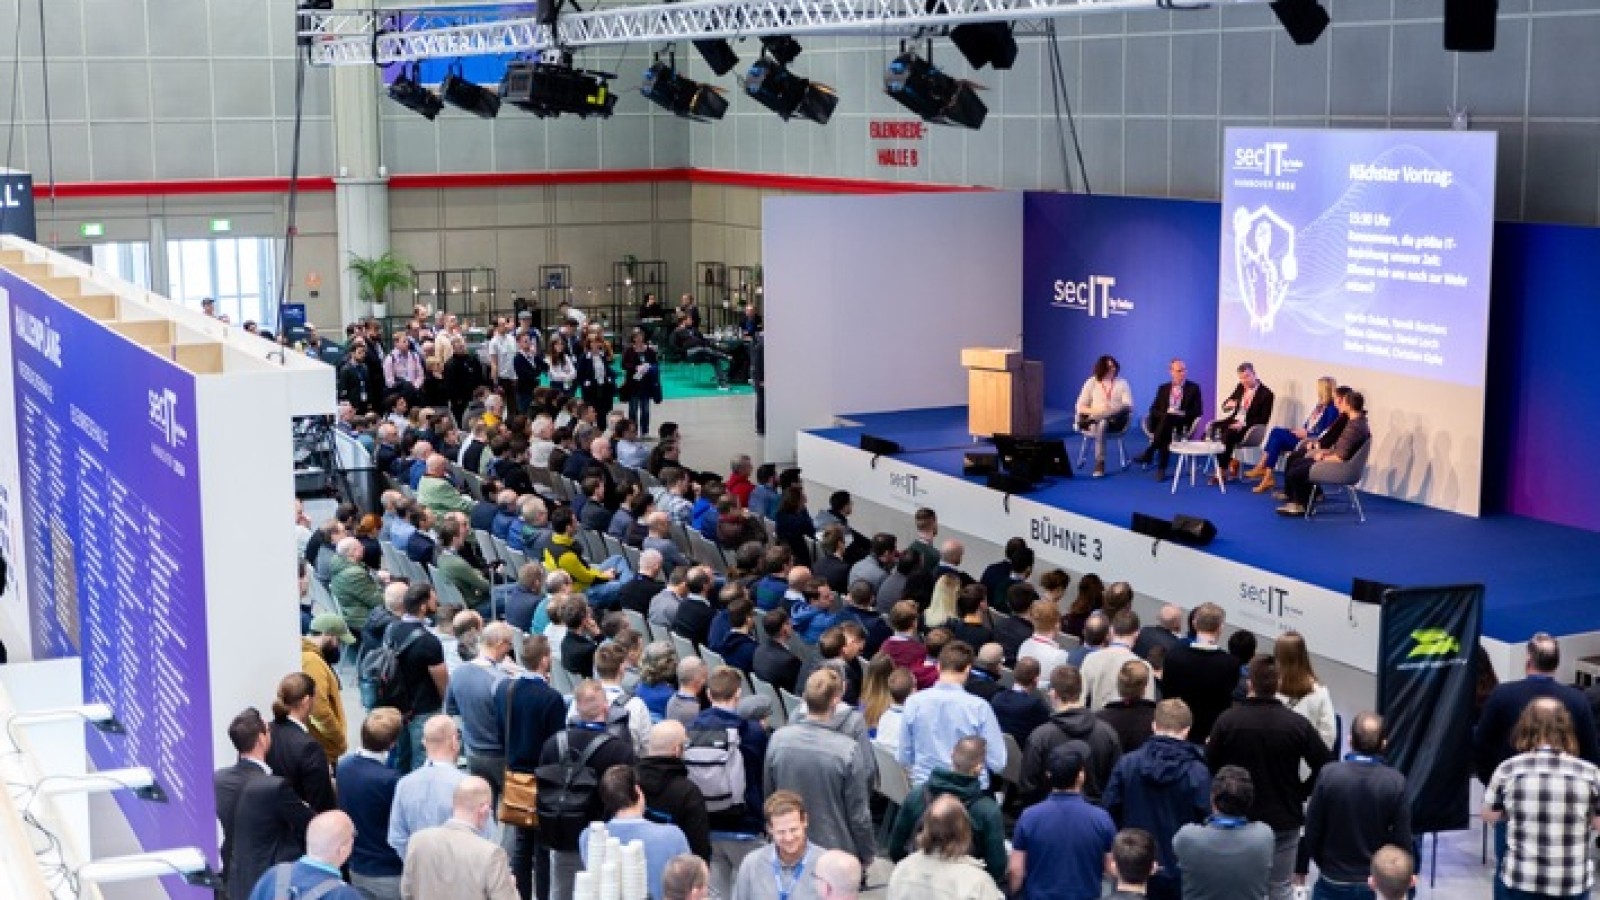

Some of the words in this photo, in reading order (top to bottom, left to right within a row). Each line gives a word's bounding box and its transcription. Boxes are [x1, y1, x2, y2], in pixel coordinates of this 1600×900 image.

[1235, 143, 1288, 176] secIT
[1350, 164, 1400, 181] Nächster
[1404, 166, 1454, 188] Vortrag:
[1054, 275, 1116, 319] secIT
[1030, 516, 1086, 557] BÜHNE
[1093, 538, 1103, 562] 3
[1239, 582, 1289, 617] secIT
